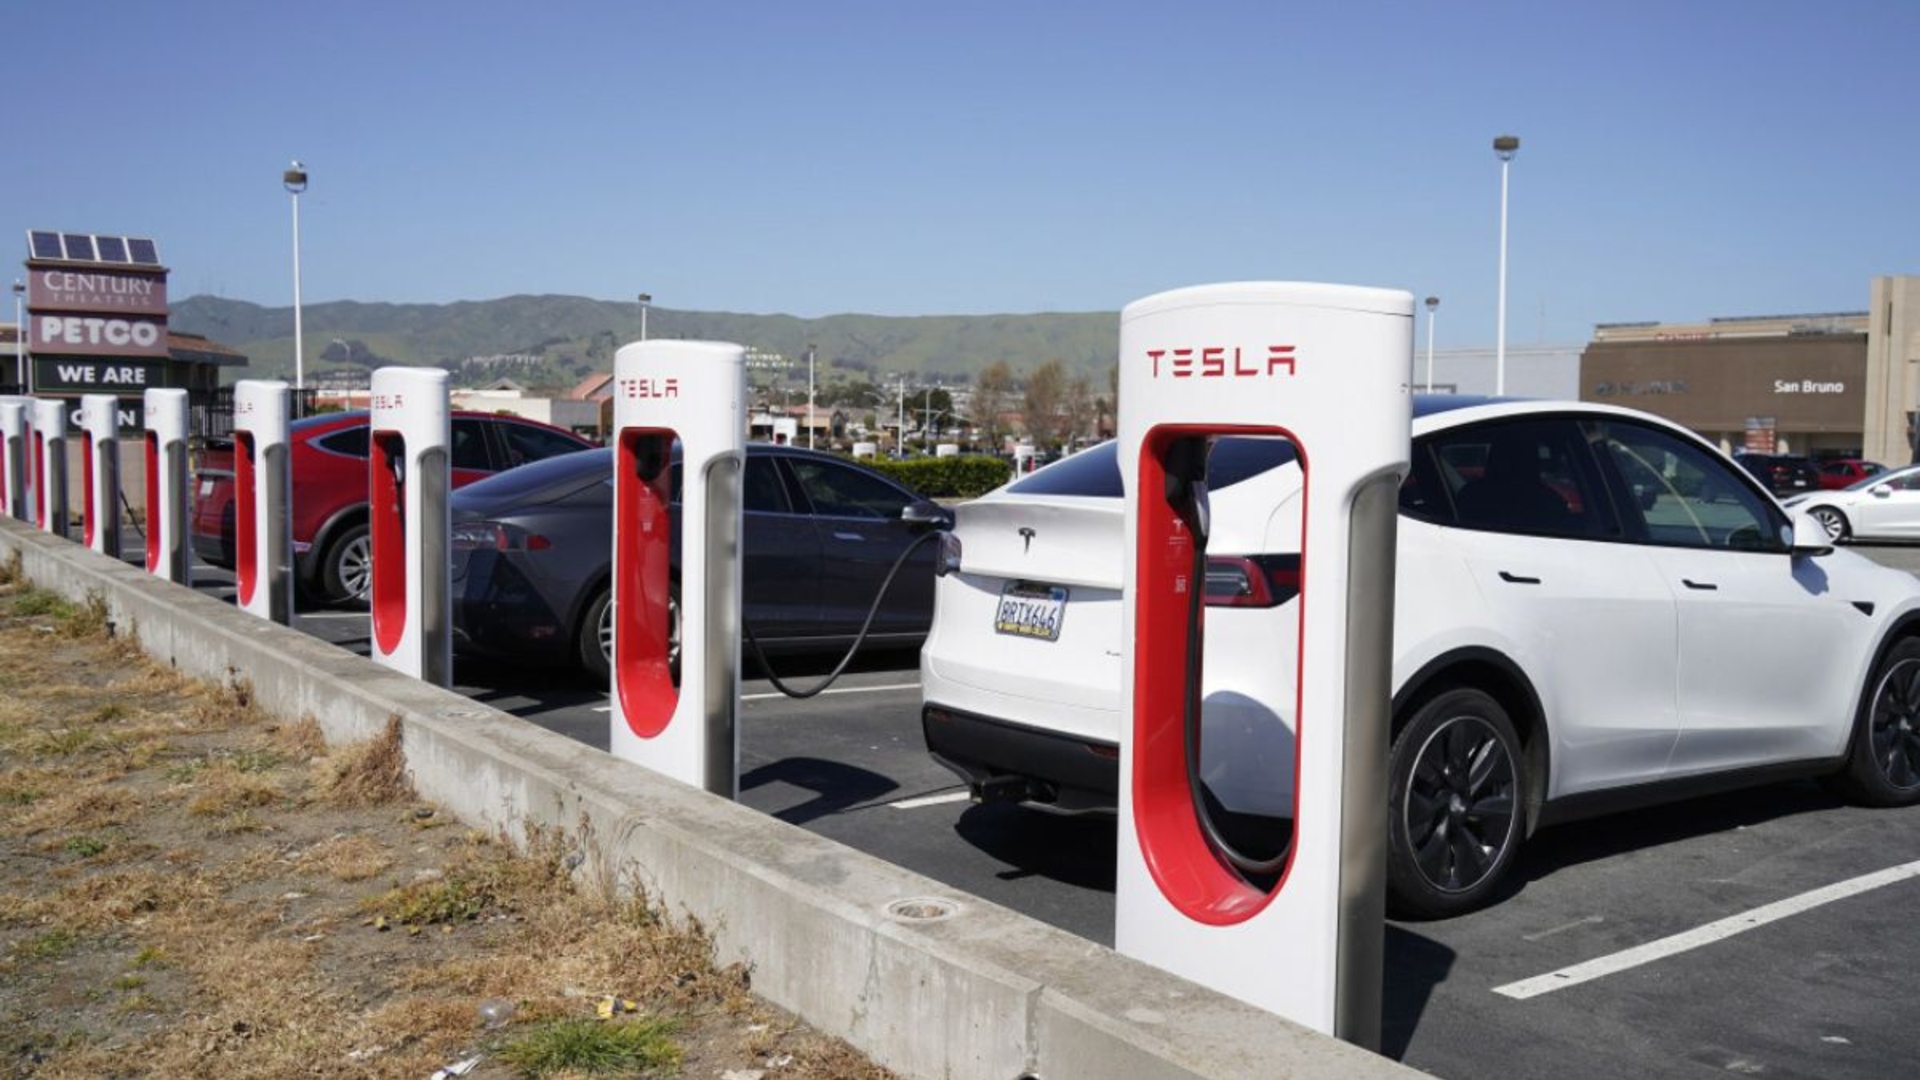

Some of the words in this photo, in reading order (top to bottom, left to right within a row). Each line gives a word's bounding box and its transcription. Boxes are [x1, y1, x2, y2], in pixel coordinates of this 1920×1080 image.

[43, 271, 156, 295] CENTURY
[42, 316, 158, 347] PETCO
[1147, 346, 1296, 378] TESLA
[57, 365, 96, 382] WE
[102, 367, 145, 384] ARE
[620, 379, 678, 398] TESLA
[1774, 380, 1799, 393] San
[1802, 380, 1844, 393] Bruno
[70, 409, 135, 427] ON
